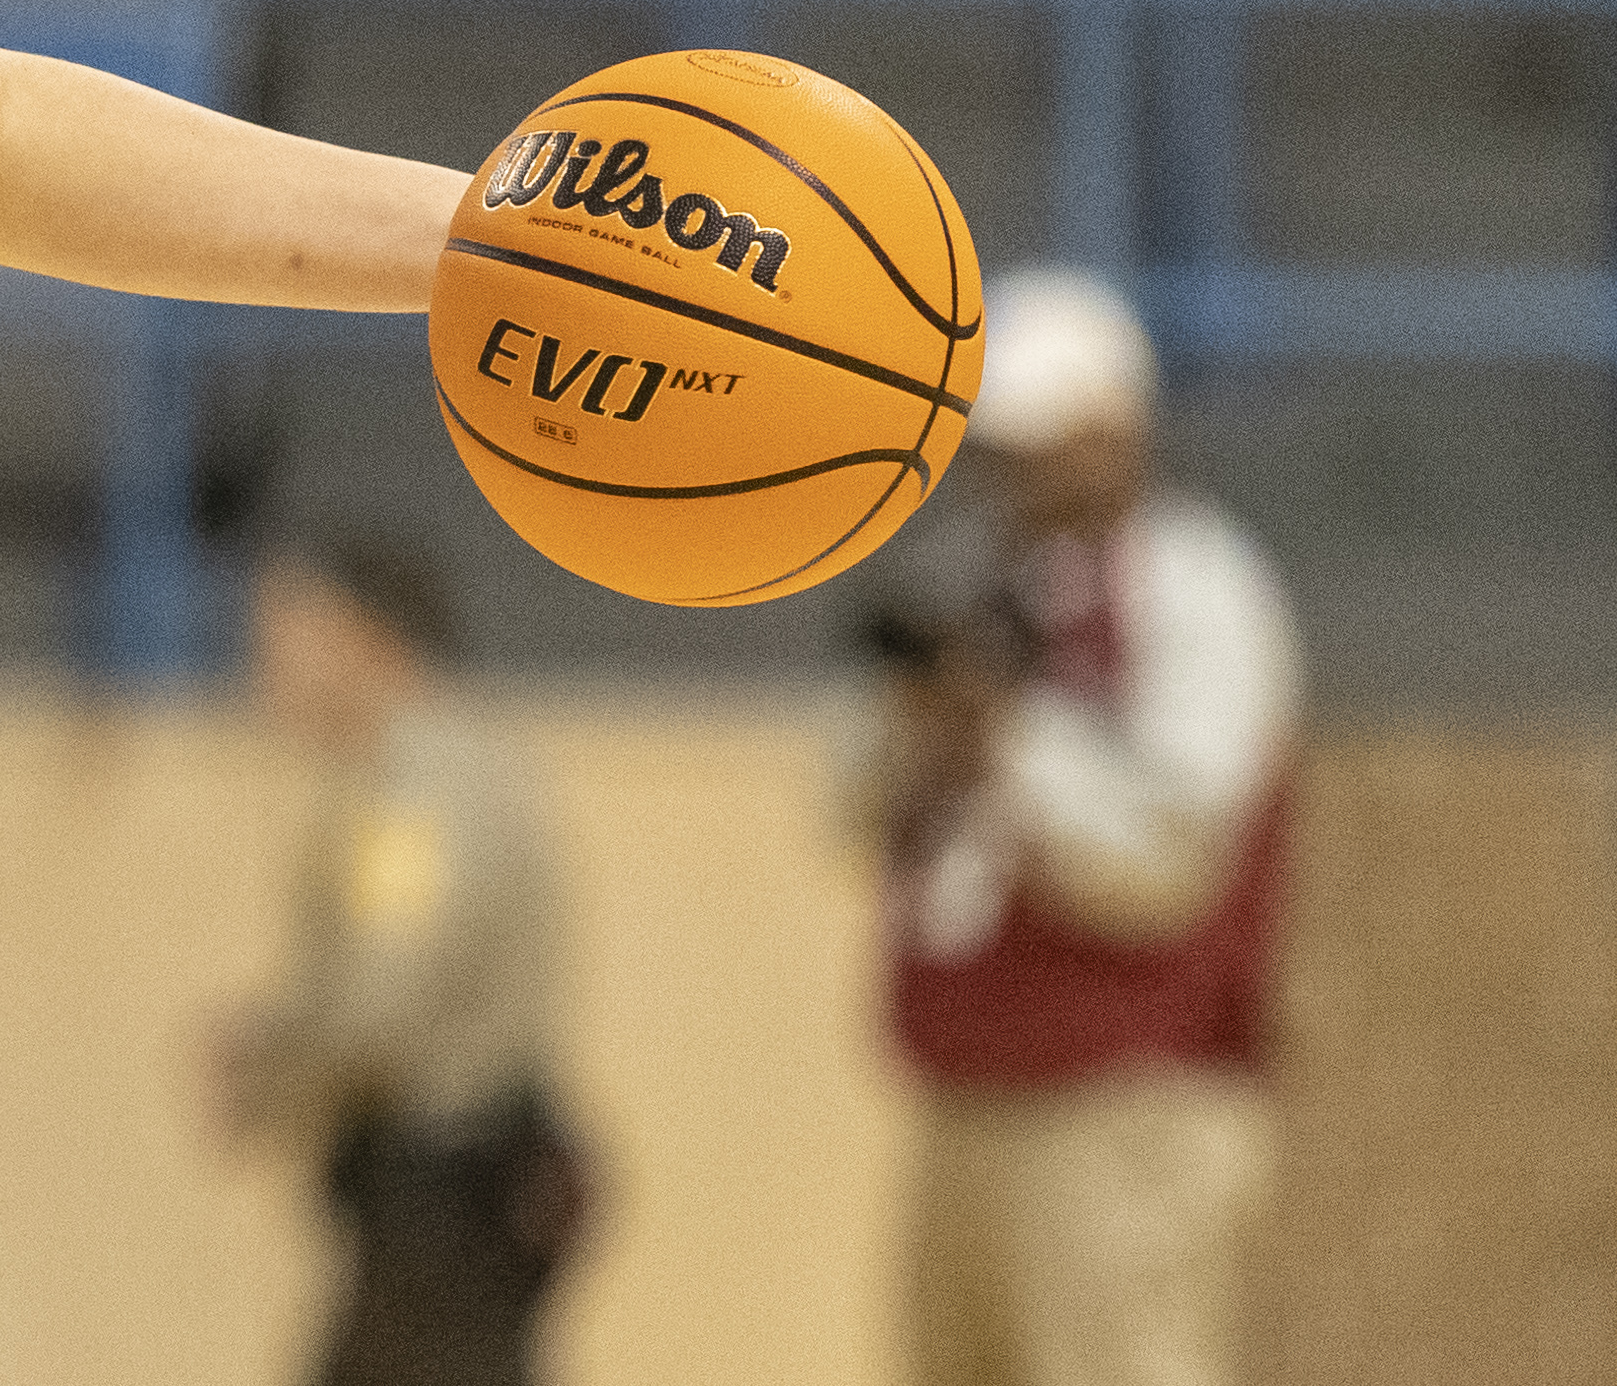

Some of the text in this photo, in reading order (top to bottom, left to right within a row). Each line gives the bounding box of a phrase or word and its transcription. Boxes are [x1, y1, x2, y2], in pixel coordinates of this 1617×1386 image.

[483, 130, 792, 297] Wilson
[527, 216, 682, 270] INDOOR GAME BALL
[477, 317, 746, 423] EVO NXT
